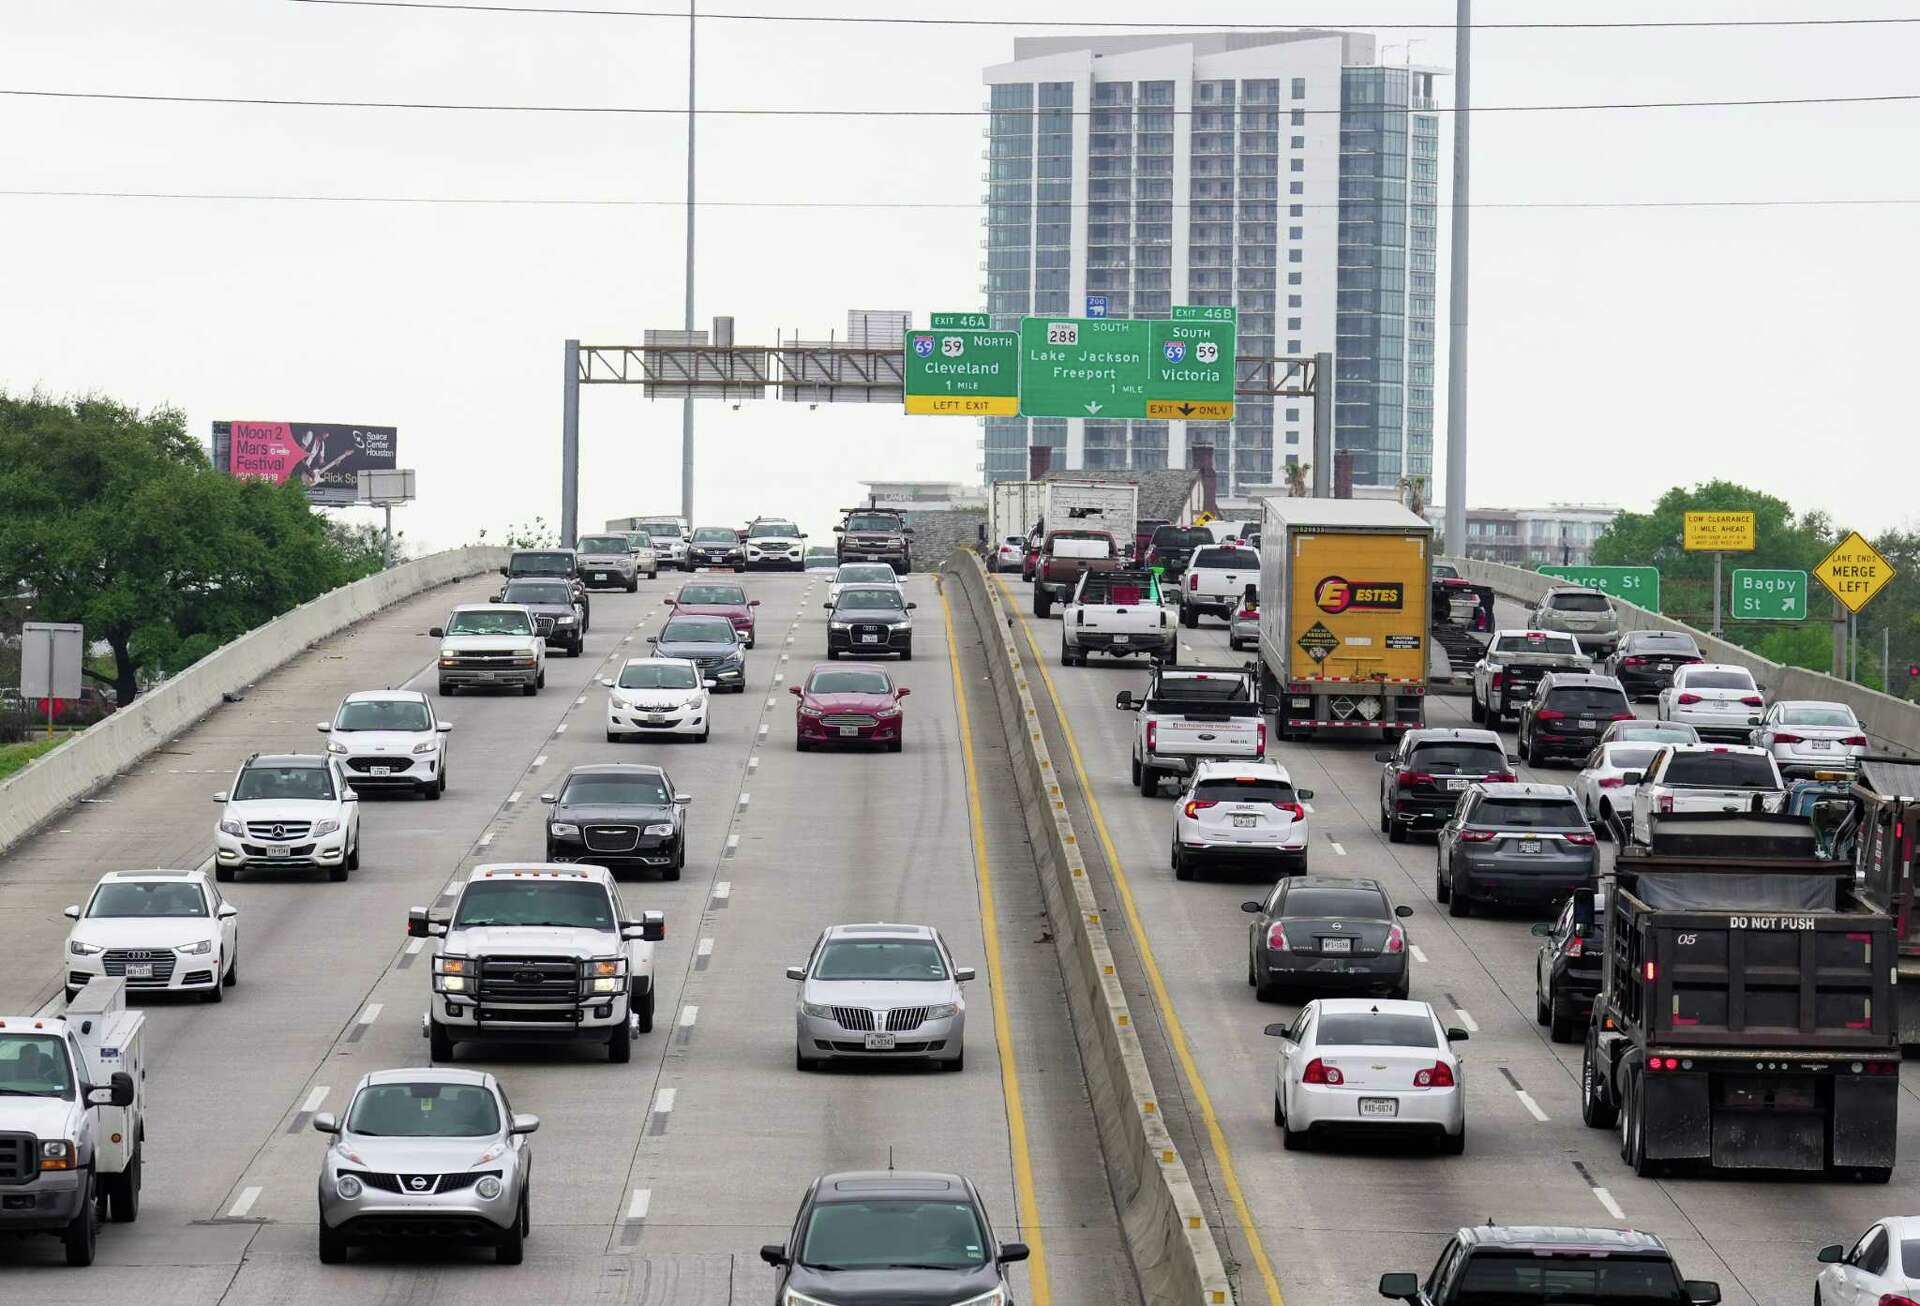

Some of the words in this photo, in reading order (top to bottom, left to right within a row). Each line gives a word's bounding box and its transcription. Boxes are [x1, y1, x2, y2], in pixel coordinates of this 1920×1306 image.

[1204, 309, 1232, 318] 46B
[960, 316, 986, 326] 46A
[1092, 323, 1129, 332] SOUTH
[1050, 330, 1076, 342] 288
[1173, 328, 1210, 338] SOUTH
[944, 340, 961, 352] 59
[974, 336, 1012, 346] NORTH
[916, 342, 932, 352] 69
[1198, 346, 1216, 358] 59
[1031, 350, 1066, 360] Lake
[1078, 351, 1140, 362] Jackson
[1166, 348, 1183, 358] 69
[925, 362, 999, 374] Cleveland
[1054, 368, 1116, 380] Freeport
[1162, 369, 1220, 381] Victoria
[946, 380, 952, 390] 1
[1110, 384, 1116, 394] 1
[1122, 386, 1144, 394] MILE
[934, 402, 960, 410] LEFT
[966, 402, 990, 410] EXIT
[1150, 405, 1173, 414] EXIT
[1200, 406, 1227, 414] ONLY
[238, 425, 272, 440] Moon
[275, 426, 282, 440] 2
[366, 432, 388, 441] Space
[237, 441, 268, 455] Mars
[366, 440, 389, 449] Center
[366, 448, 394, 456] Houston
[237, 456, 284, 470] Festival
[1832, 554, 1852, 562] LANE
[1832, 566, 1876, 578] MERGE
[1622, 576, 1640, 588] St
[1744, 577, 1796, 592] Bagby
[1838, 582, 1870, 592] LEFT
[1318, 583, 1348, 606] E
[1356, 588, 1398, 602] ESTES
[1744, 597, 1760, 610] St
[1730, 916, 1748, 928] DO
[1752, 917, 1777, 929] NOT
[1781, 918, 1815, 930] PUSH
[1678, 934, 1698, 944] 05
